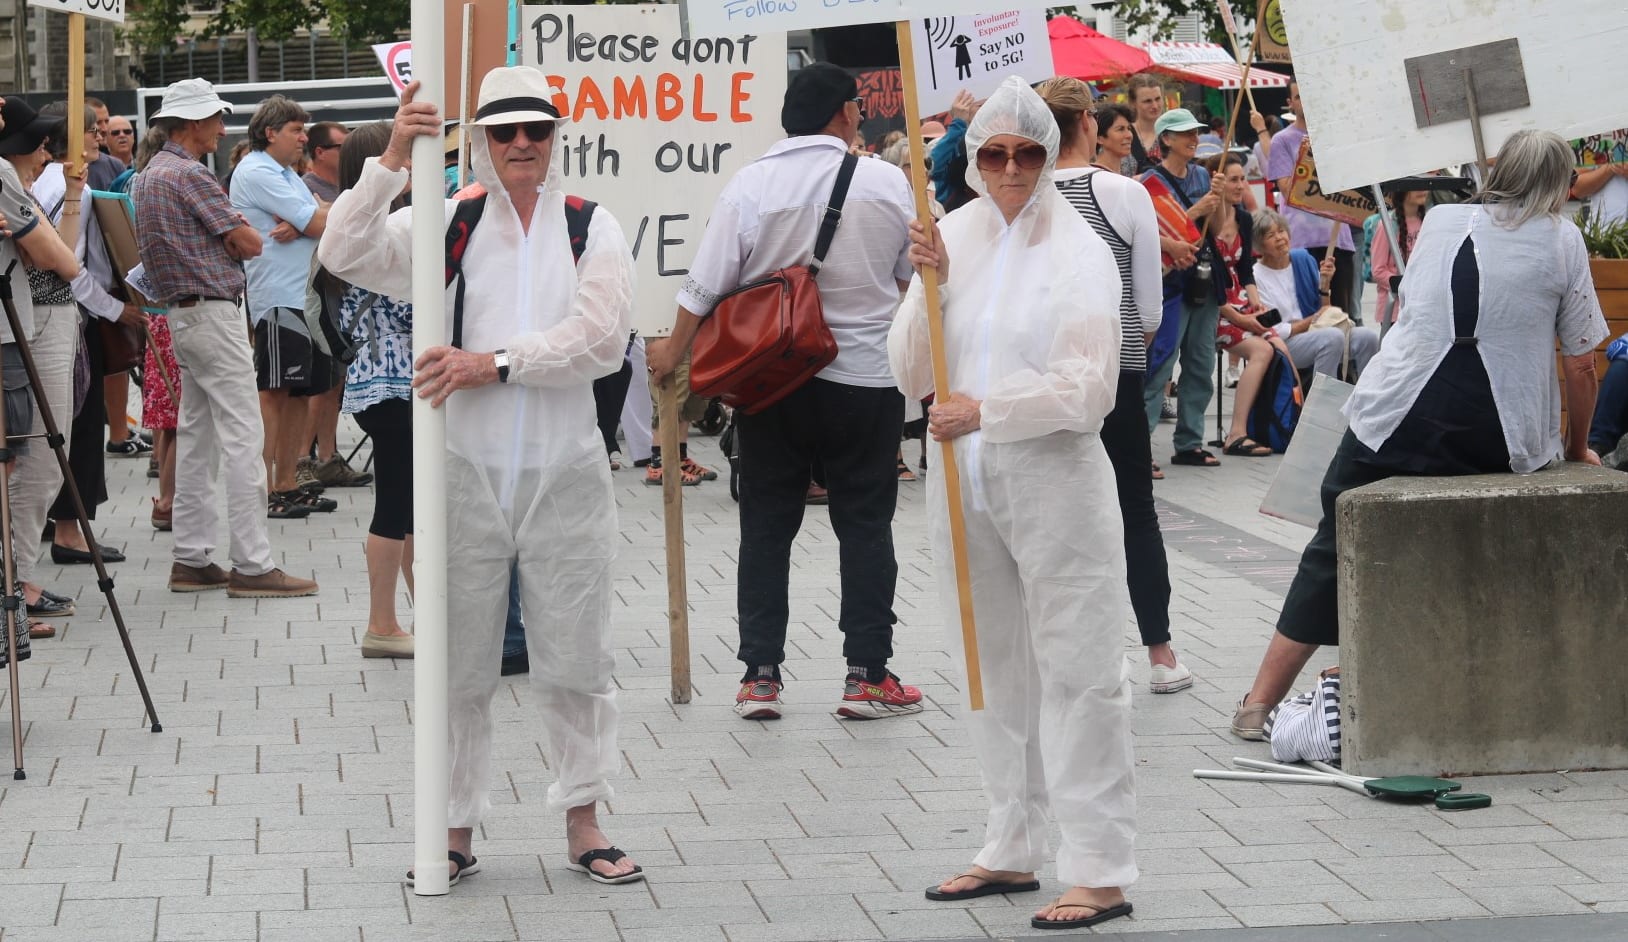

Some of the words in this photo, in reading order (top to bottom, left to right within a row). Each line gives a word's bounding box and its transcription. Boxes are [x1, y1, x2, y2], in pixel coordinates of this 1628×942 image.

[723, 0, 797, 21] Follow
[973, 9, 1021, 28] Involuntary
[978, 18, 1020, 37] Exposure!
[531, 13, 659, 65] Please
[979, 41, 1002, 56] Say
[1005, 32, 1025, 49] NO
[985, 59, 999, 72] to
[1001, 50, 1025, 67] 5G!
[562, 133, 620, 178] ith
[655, 140, 732, 174] our
